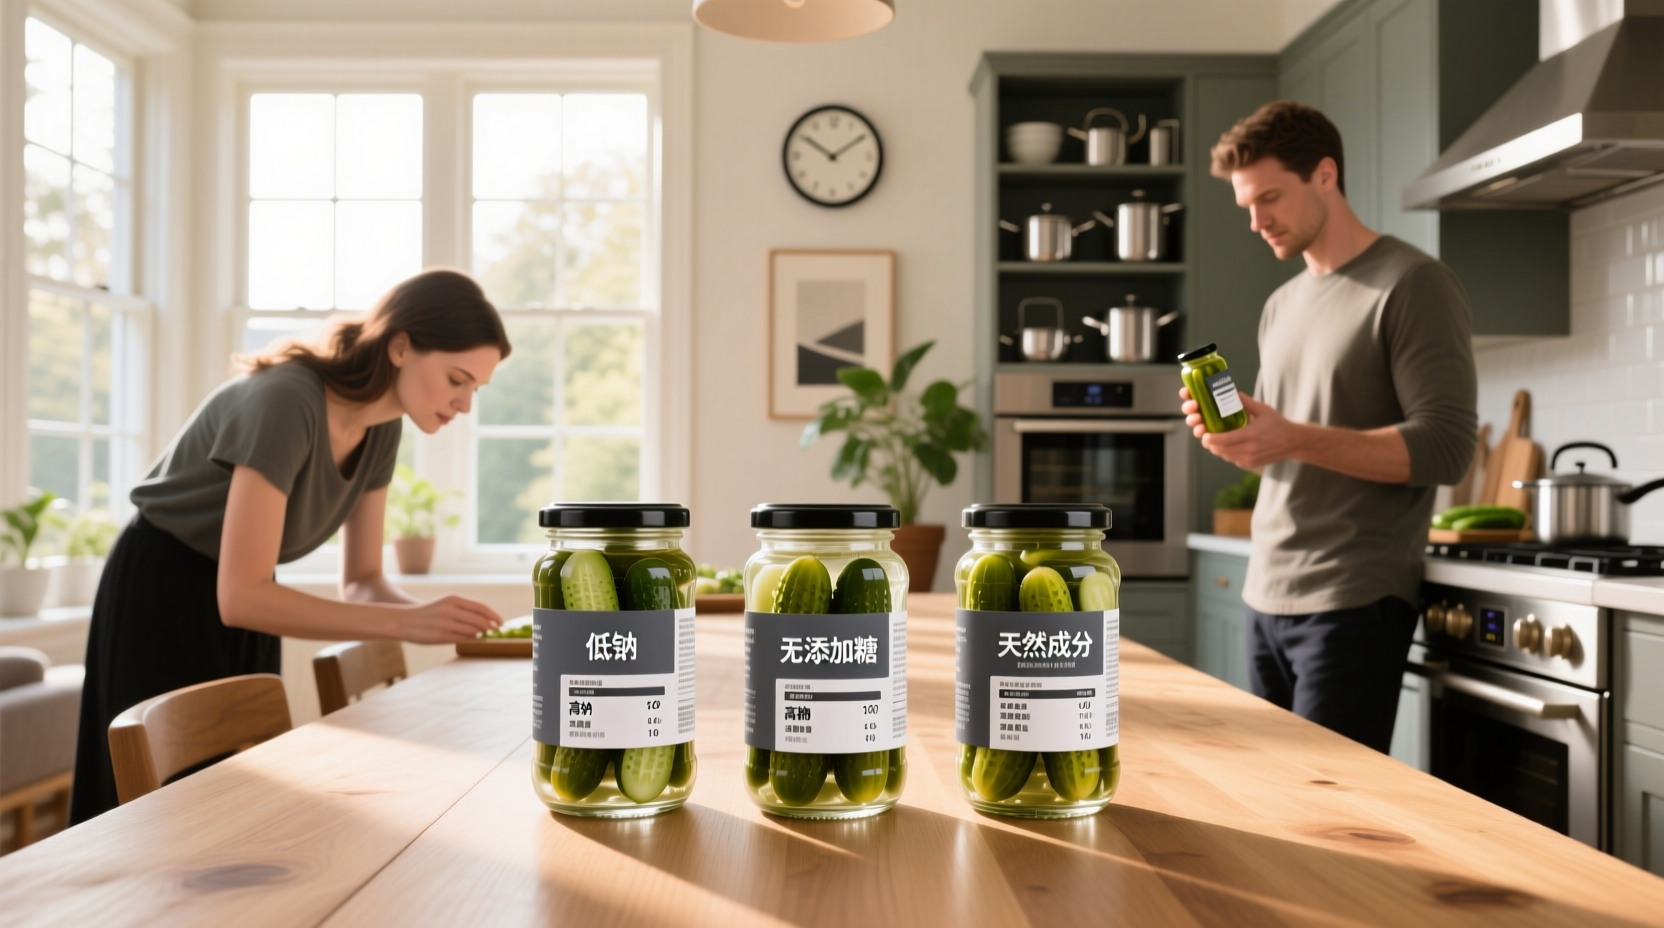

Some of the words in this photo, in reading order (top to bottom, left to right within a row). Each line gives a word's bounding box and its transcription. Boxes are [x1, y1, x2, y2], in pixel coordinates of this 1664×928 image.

[585, 630, 638, 662] 低钠
[780, 634, 879, 665] 无添加糖
[997, 630, 1093, 659] 天然成分
[648, 729, 659, 738] 10
